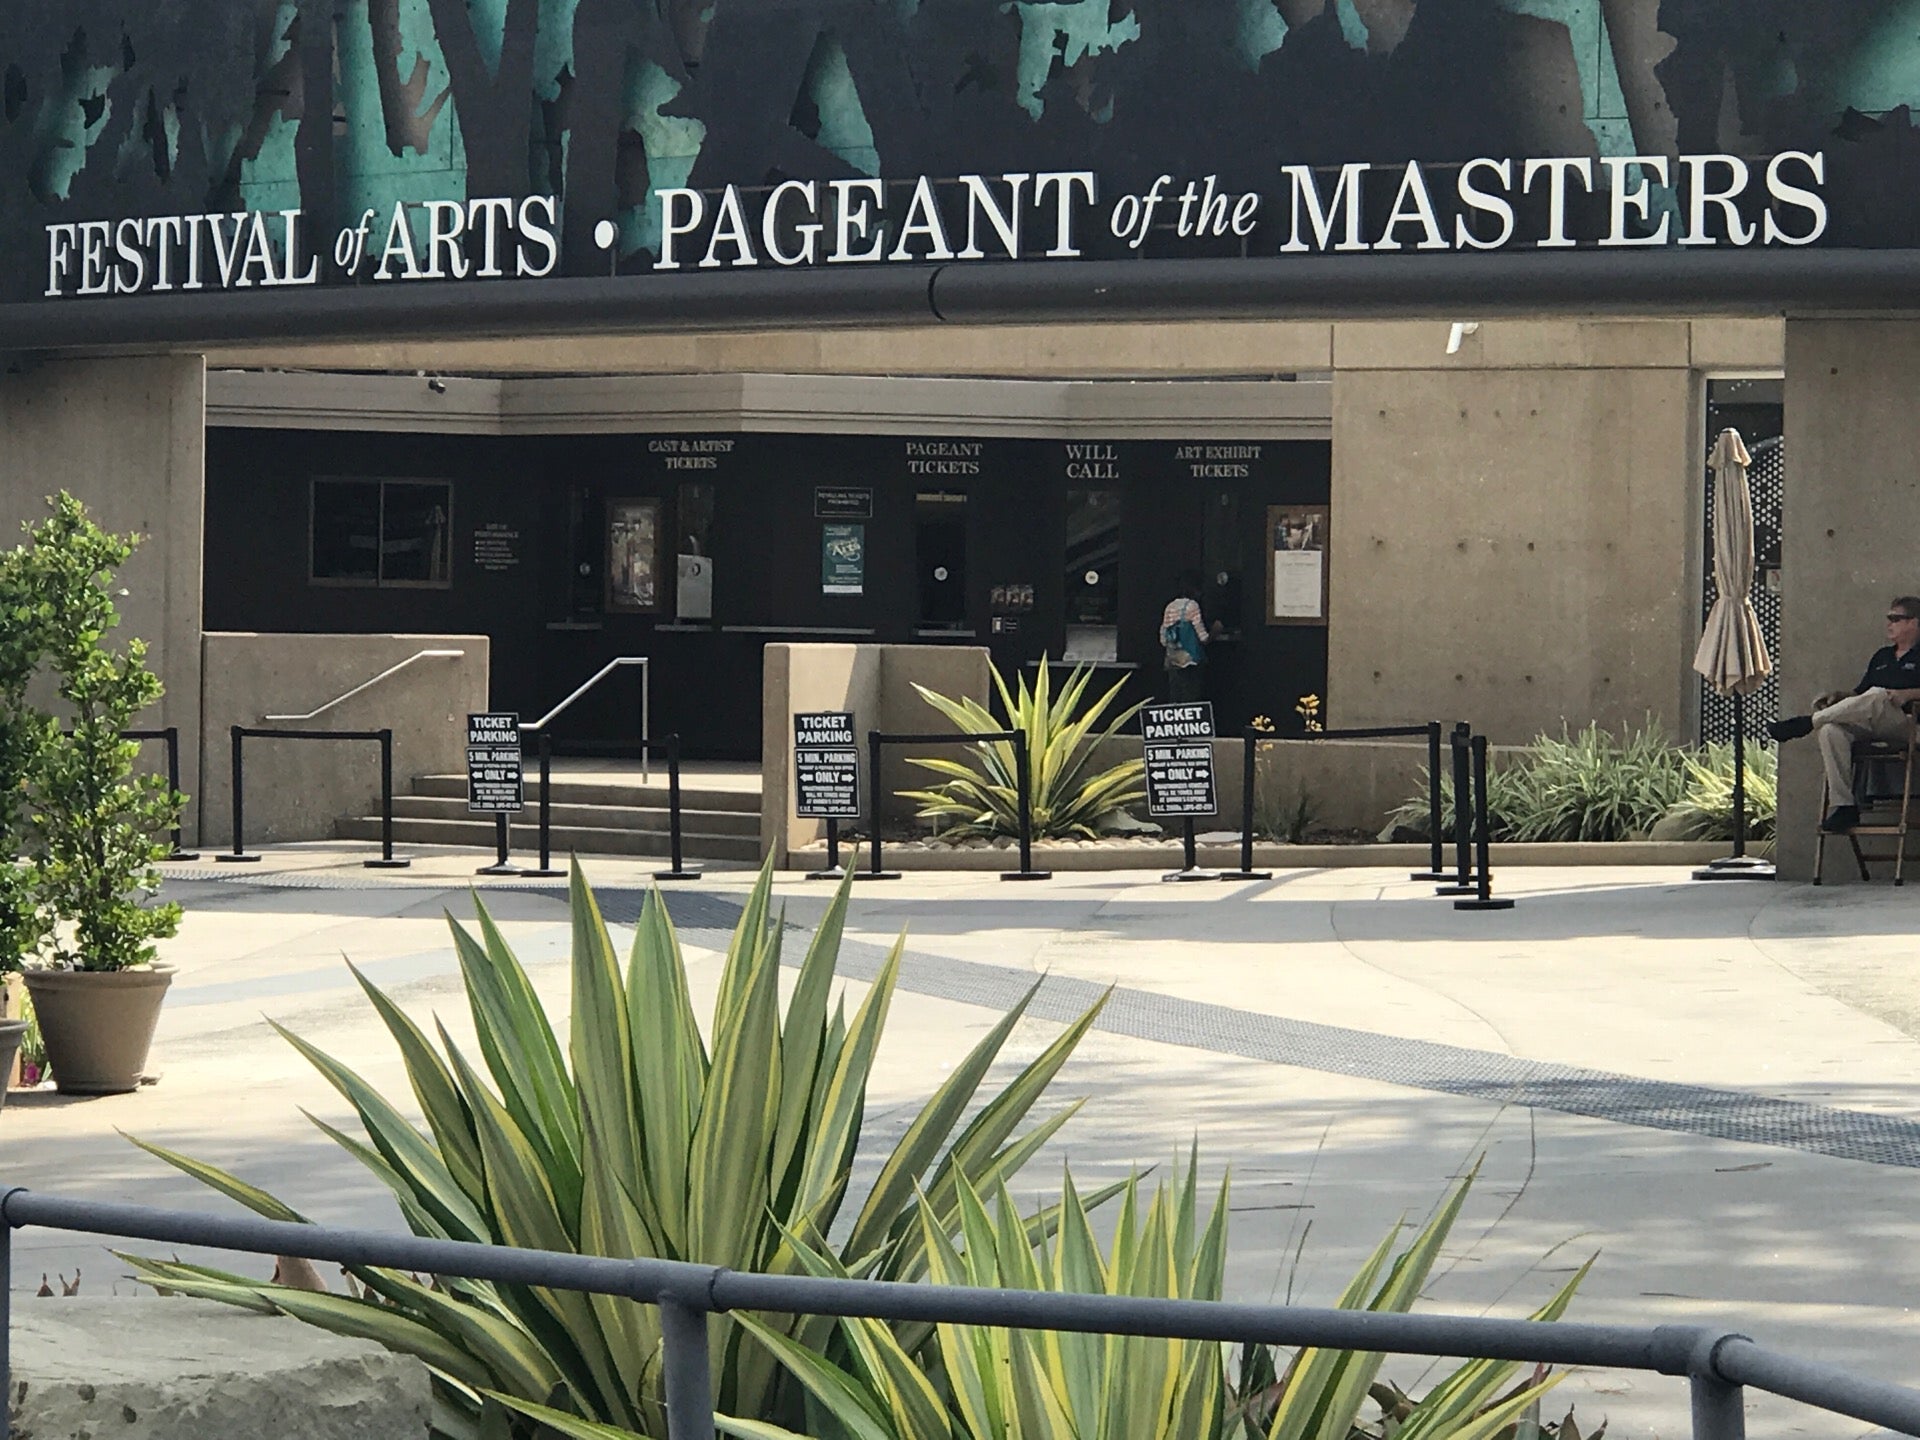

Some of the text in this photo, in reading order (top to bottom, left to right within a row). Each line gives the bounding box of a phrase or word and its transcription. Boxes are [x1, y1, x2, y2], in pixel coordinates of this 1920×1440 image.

[44, 150, 1828, 297] FESTIVAL of ARTS PAGEANT of the MASTERS
[648, 440, 735, 453] CAST & ARTIST
[905, 442, 983, 456] PAGEANT
[1065, 444, 1118, 461] WILL
[1174, 446, 1261, 460] ART EXHIBIT
[664, 456, 718, 470] TICKETS
[907, 460, 980, 474] TICKETS
[1065, 463, 1119, 479] CALL
[1190, 464, 1249, 478] TICKETS
[1149, 707, 1203, 723] TICKET
[473, 717, 512, 729] TICKET
[801, 716, 846, 729] TICKET
[470, 731, 517, 742] PARKING
[797, 730, 852, 743] PARKING
[1145, 722, 1211, 738] PARKING
[469, 752, 474, 762] 5
[491, 752, 519, 762] PARKING
[797, 753, 856, 763] 5 MIN. PARKING
[1147, 748, 1210, 761] 5 MIN. PARKING
[484, 769, 506, 781] ONLY
[815, 771, 840, 783] ONLY
[1167, 768, 1194, 781] ONLY
